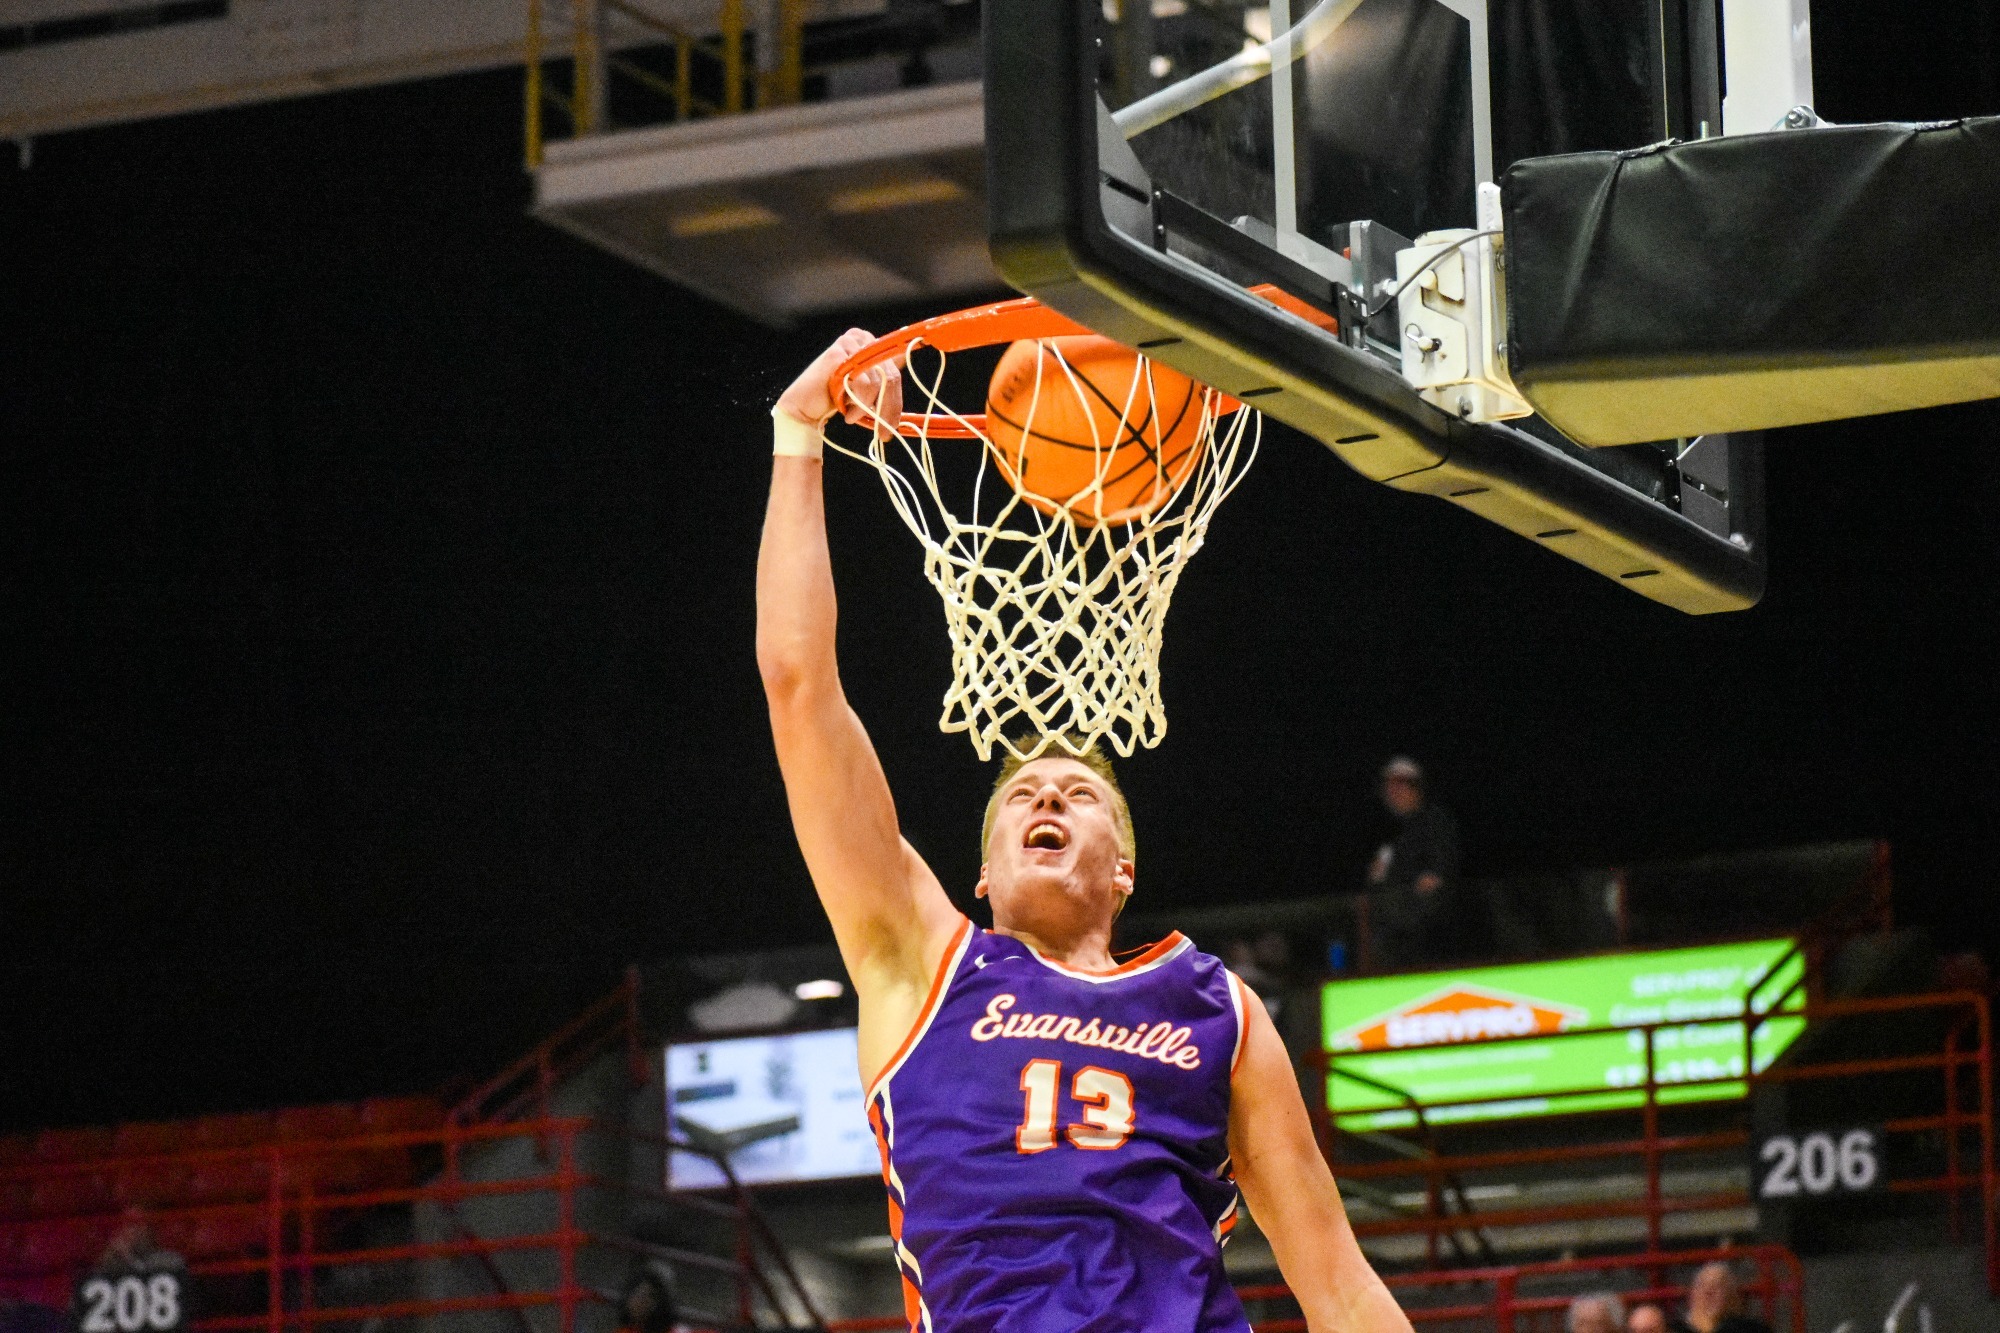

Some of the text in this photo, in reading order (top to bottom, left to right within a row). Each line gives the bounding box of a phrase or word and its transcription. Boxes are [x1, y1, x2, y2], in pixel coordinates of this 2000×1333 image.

[971, 993, 1201, 1070] Evansville
[1016, 1058, 1136, 1155] 13
[1760, 1129, 1877, 1198] 206
[80, 1273, 180, 1332] 208
